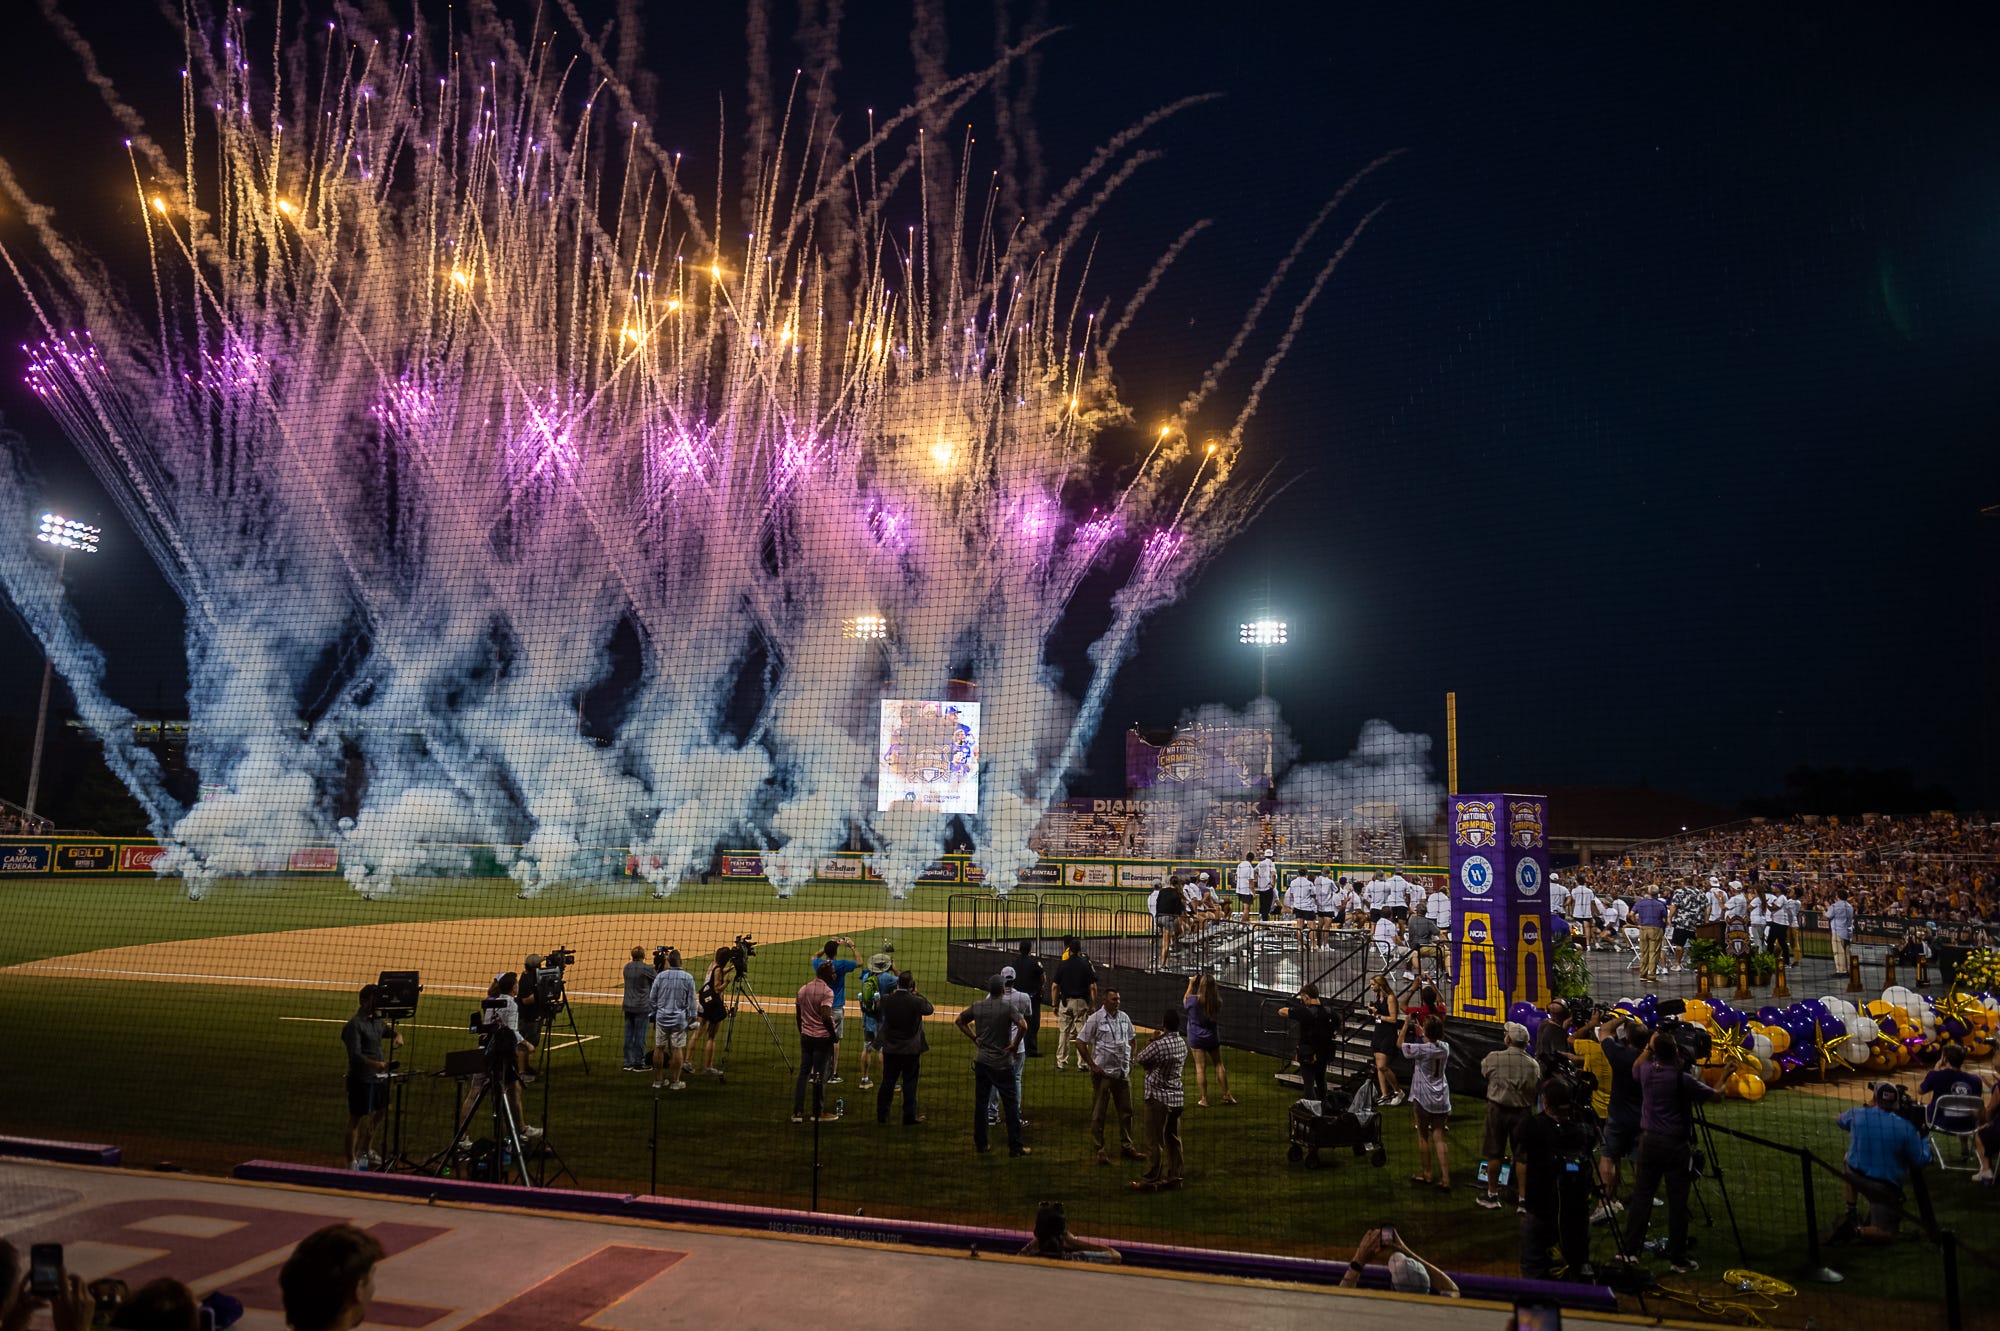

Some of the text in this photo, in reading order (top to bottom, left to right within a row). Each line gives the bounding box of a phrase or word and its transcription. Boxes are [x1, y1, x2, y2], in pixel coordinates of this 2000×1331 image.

[1166, 746, 1199, 754] NATIONAL
[1463, 812, 1488, 821] NATIONAL
[1458, 820, 1494, 831] CHAMPIONS
[4, 855, 37, 863] CAMPUS
[1469, 930, 1487, 938] NCAA
[1523, 932, 1538, 940] NCAA
